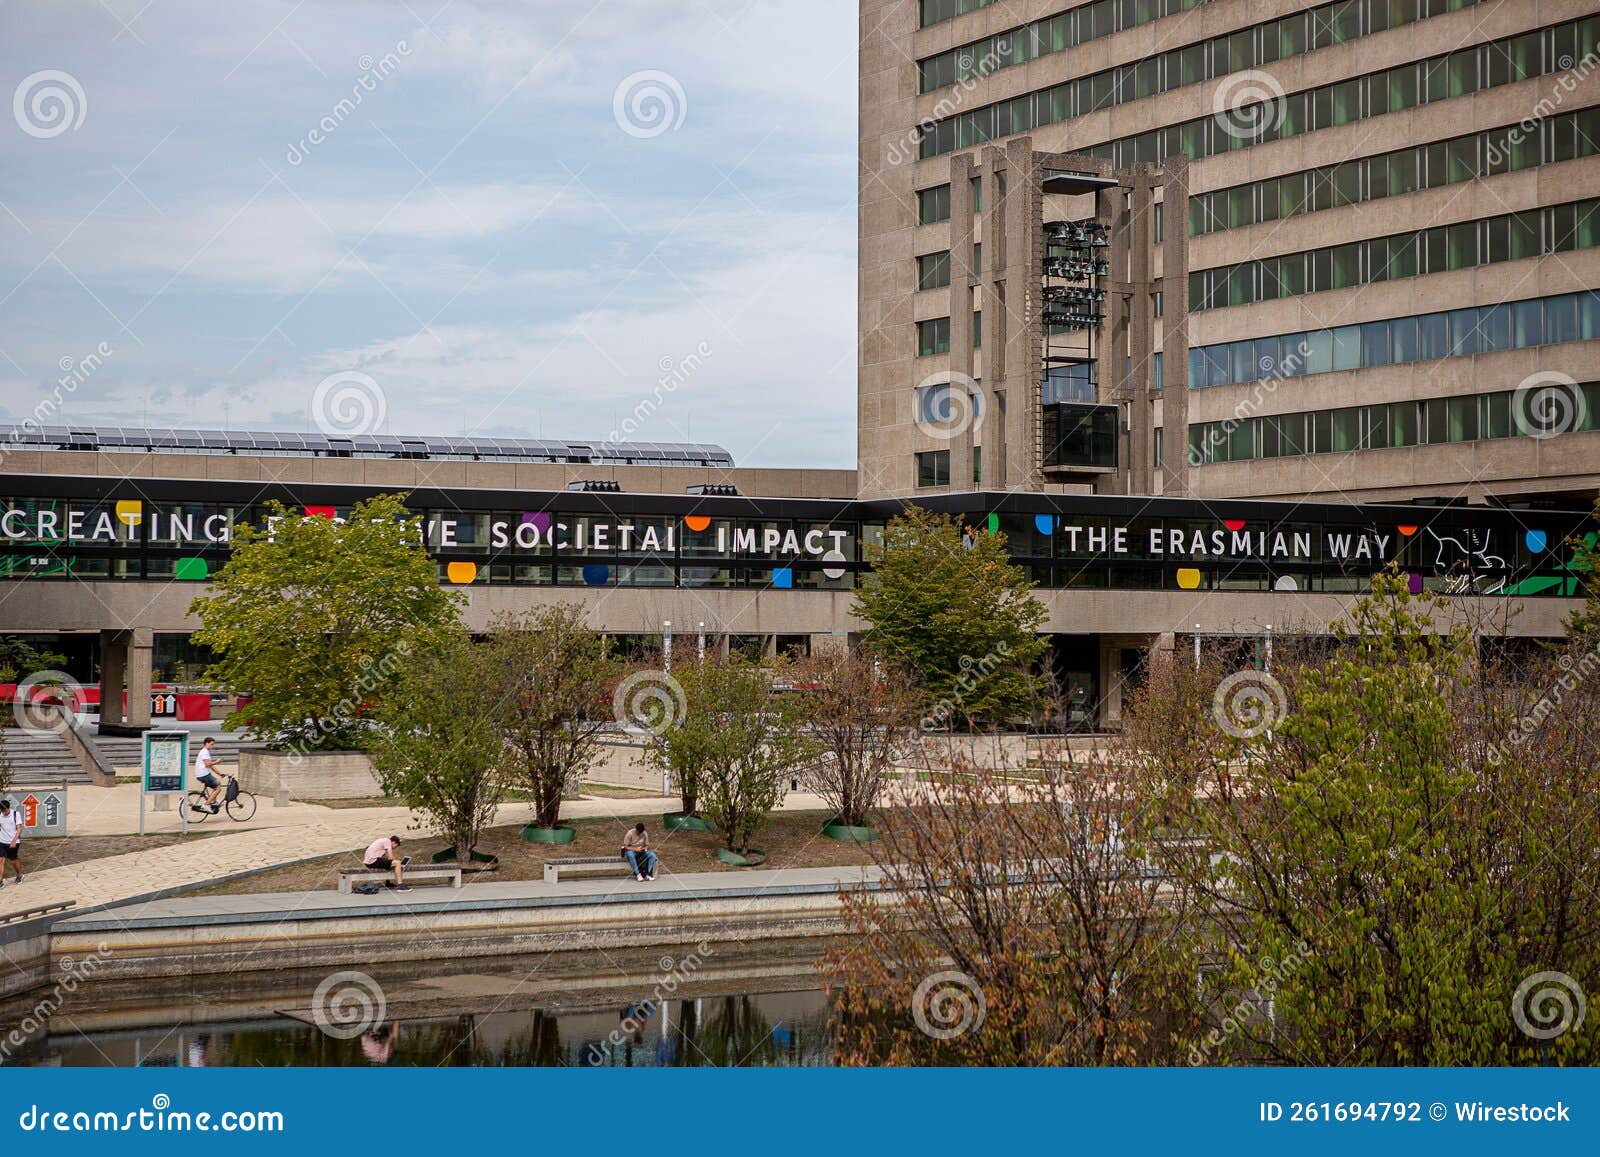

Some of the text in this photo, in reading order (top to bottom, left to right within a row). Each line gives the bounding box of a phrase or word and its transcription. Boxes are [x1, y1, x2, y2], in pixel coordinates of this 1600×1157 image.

[2, 509, 229, 542] CREATING
[492, 521, 676, 552] SOCIETAL
[718, 527, 847, 556] IMPACT
[1064, 526, 1389, 559] THE ERASMIAN WAY
